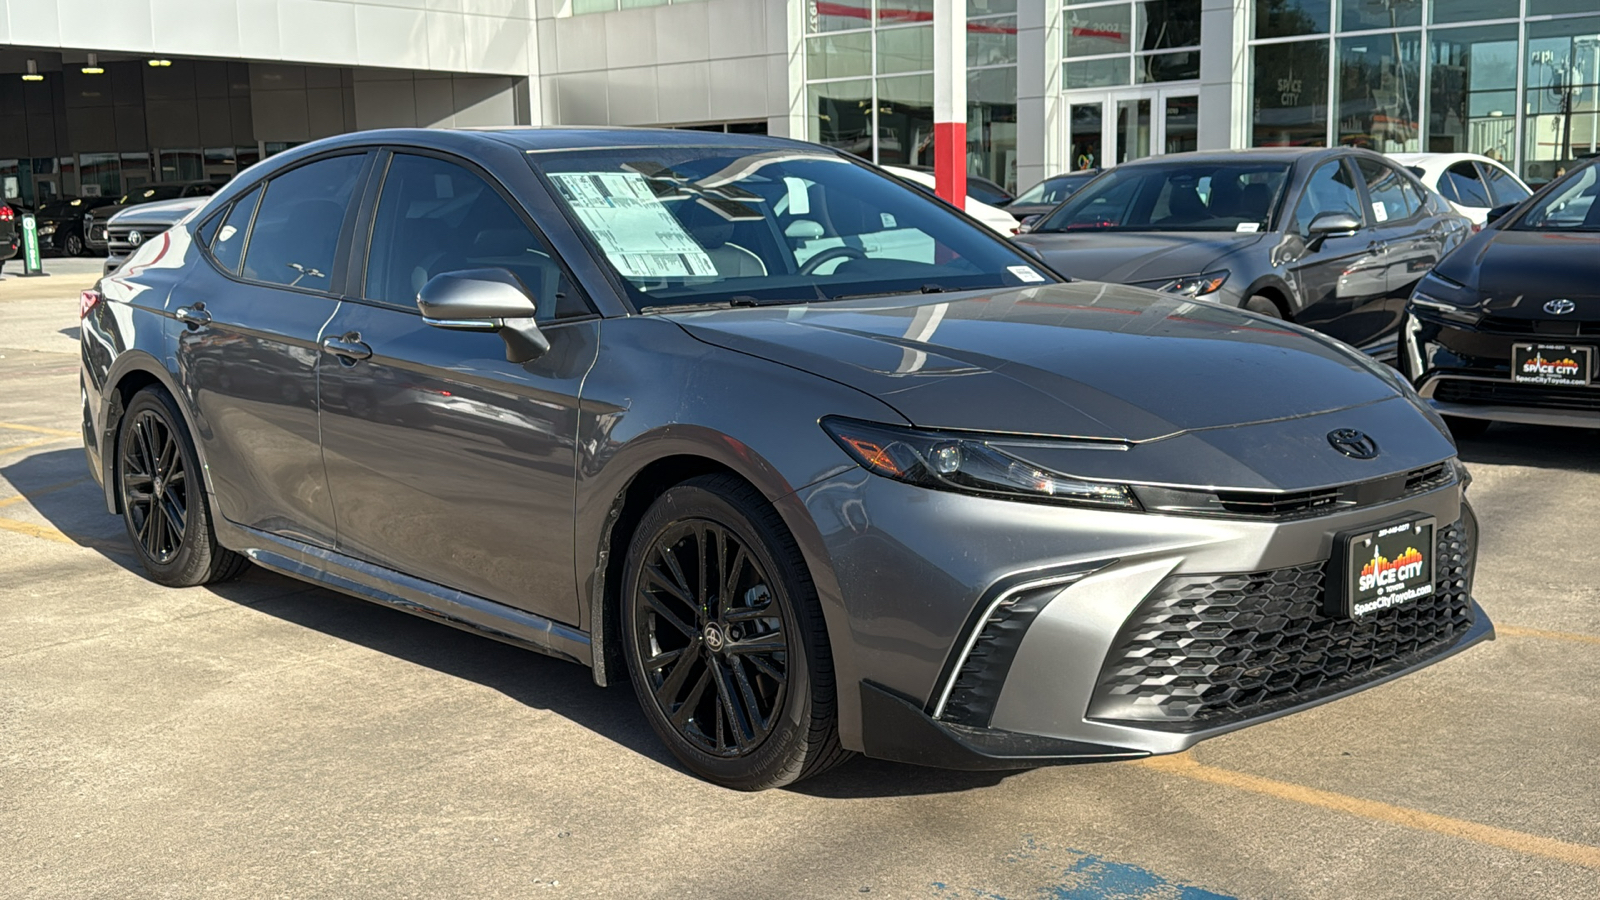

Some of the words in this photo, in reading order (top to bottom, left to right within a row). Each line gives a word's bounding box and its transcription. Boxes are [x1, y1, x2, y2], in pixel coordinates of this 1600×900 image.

[809, 1, 818, 33] 1937
[1277, 79, 1302, 93] SPACE
[1281, 93, 1299, 106] CITY
[1523, 364, 1554, 374] SPACE
[1556, 366, 1579, 375] CITY
[1516, 375, 1586, 386] SpaceCityToyota.com
[1359, 568, 1396, 592] SPACE
[1397, 561, 1423, 581] CITY
[1354, 584, 1432, 616] SpaceCityToyota.com
